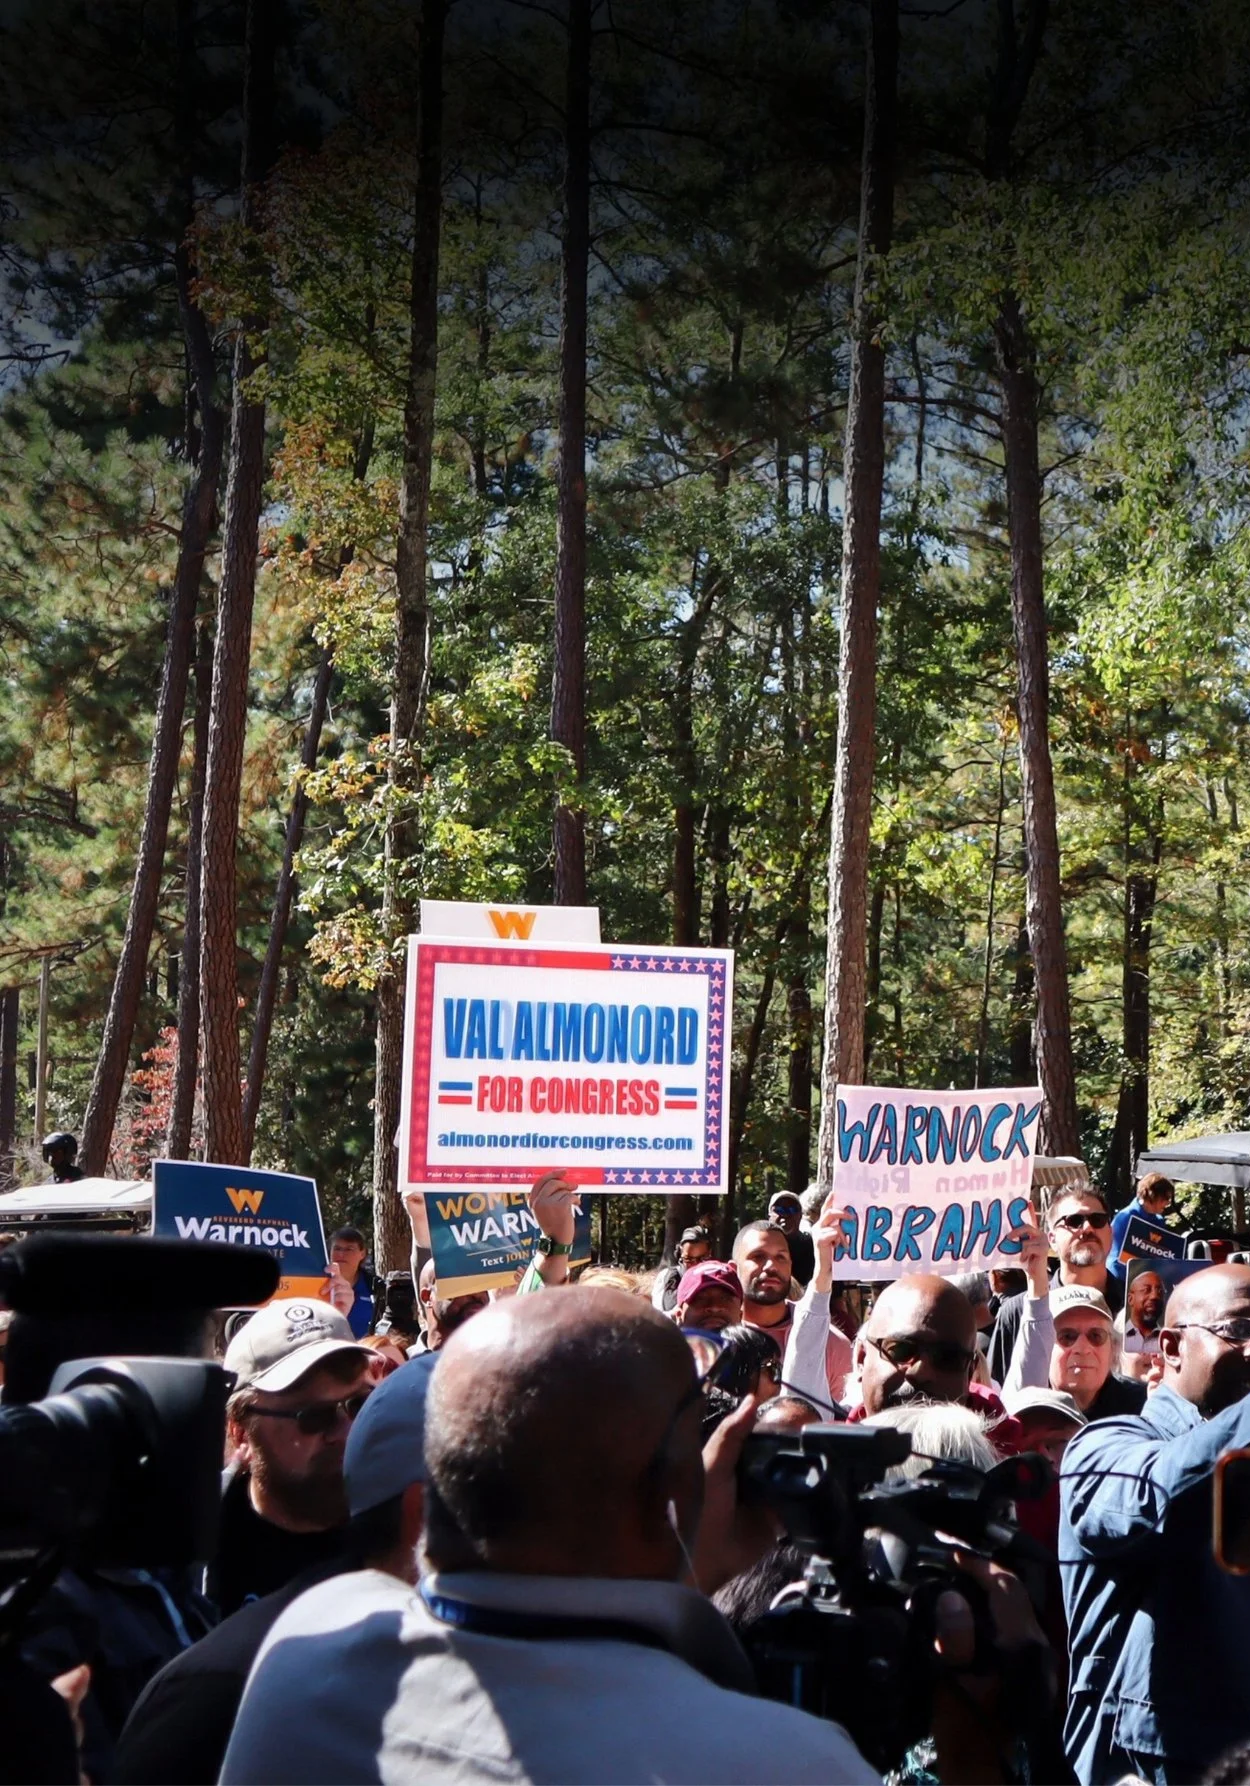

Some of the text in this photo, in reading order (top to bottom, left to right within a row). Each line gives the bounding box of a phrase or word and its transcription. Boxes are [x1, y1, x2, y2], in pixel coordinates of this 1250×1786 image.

[443, 998, 699, 1065] VAL ALMONORD
[477, 1076, 660, 1116] FOR CONGRESS
[437, 1132, 694, 1151] almonordforcongress.com
[837, 1099, 1041, 1165] WARNOCK
[436, 1192, 530, 1220] WOME
[174, 1216, 310, 1248] Warnock
[834, 1197, 1029, 1261] ABRAMS
[481, 1256, 504, 1267] Text
[505, 1251, 530, 1264] JOIN
[1131, 1235, 1175, 1259] Warnock
